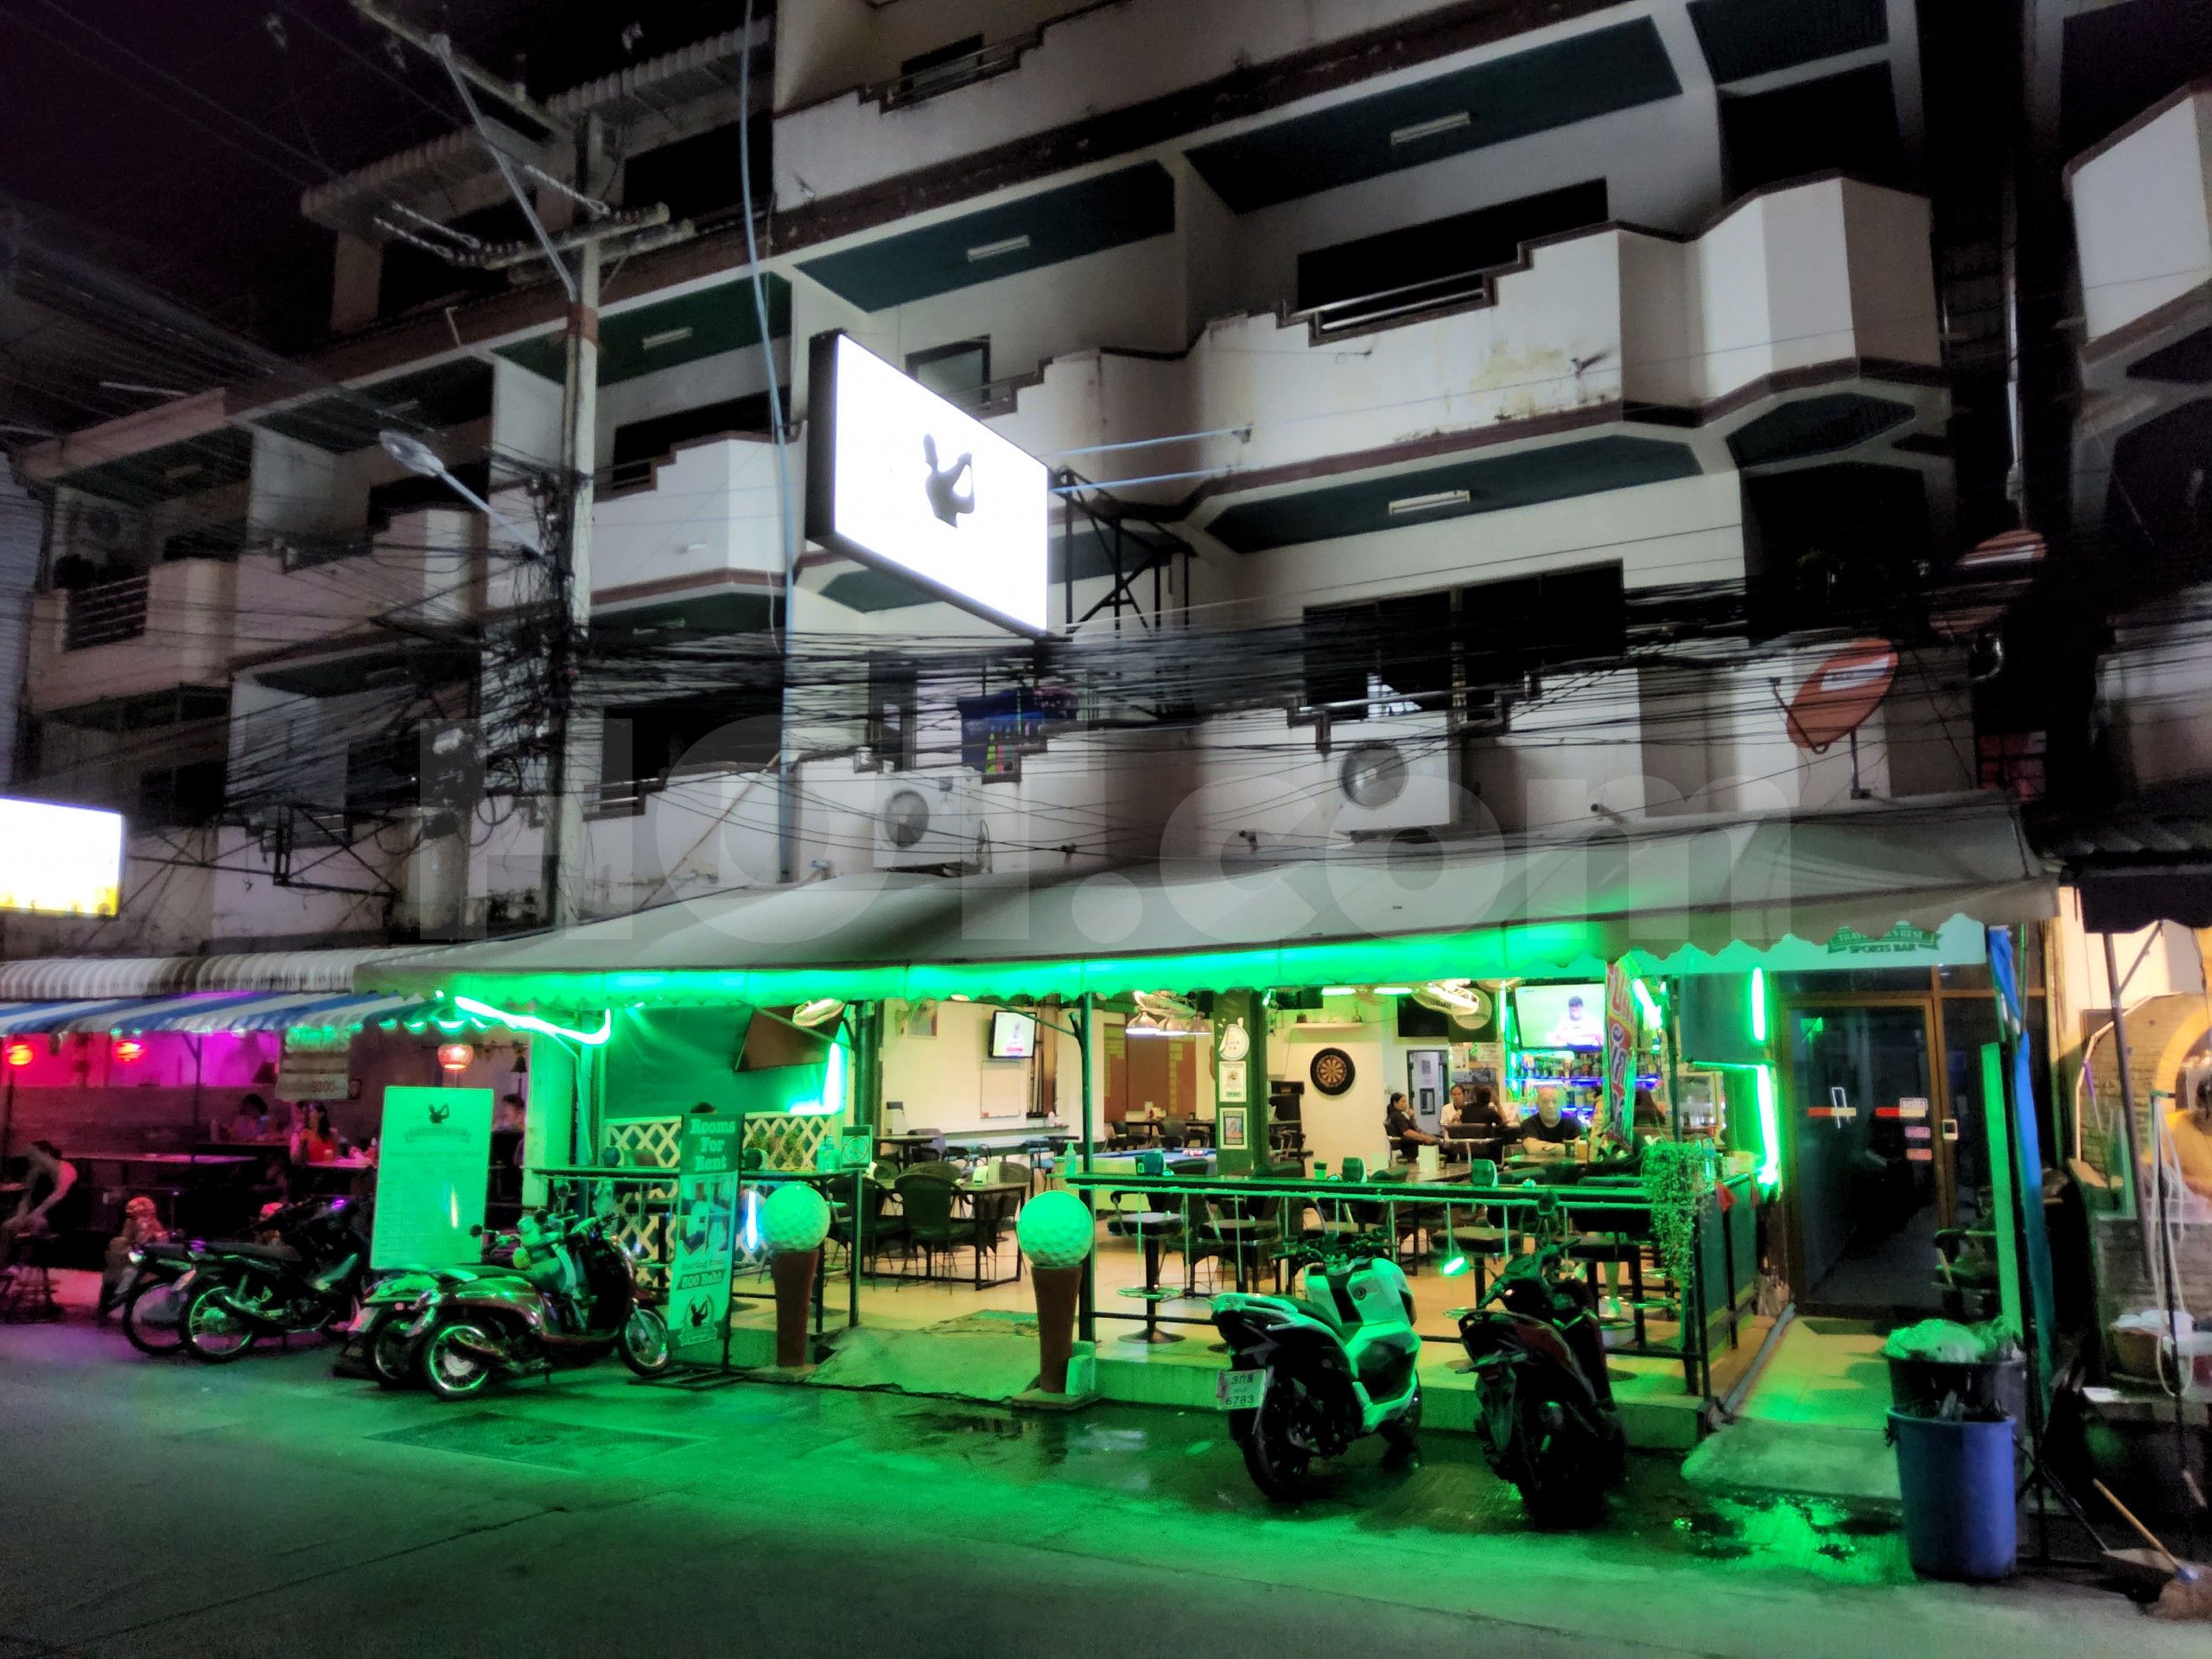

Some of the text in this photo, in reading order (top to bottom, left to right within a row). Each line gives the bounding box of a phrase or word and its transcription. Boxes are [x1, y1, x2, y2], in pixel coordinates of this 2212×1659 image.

[1849, 943, 1916, 954] SPORTS BAR
[690, 1118, 735, 1134] Rooms
[700, 1136, 725, 1152] For
[695, 1154, 727, 1171] Rent
[1226, 1395, 1255, 1406] 6783
